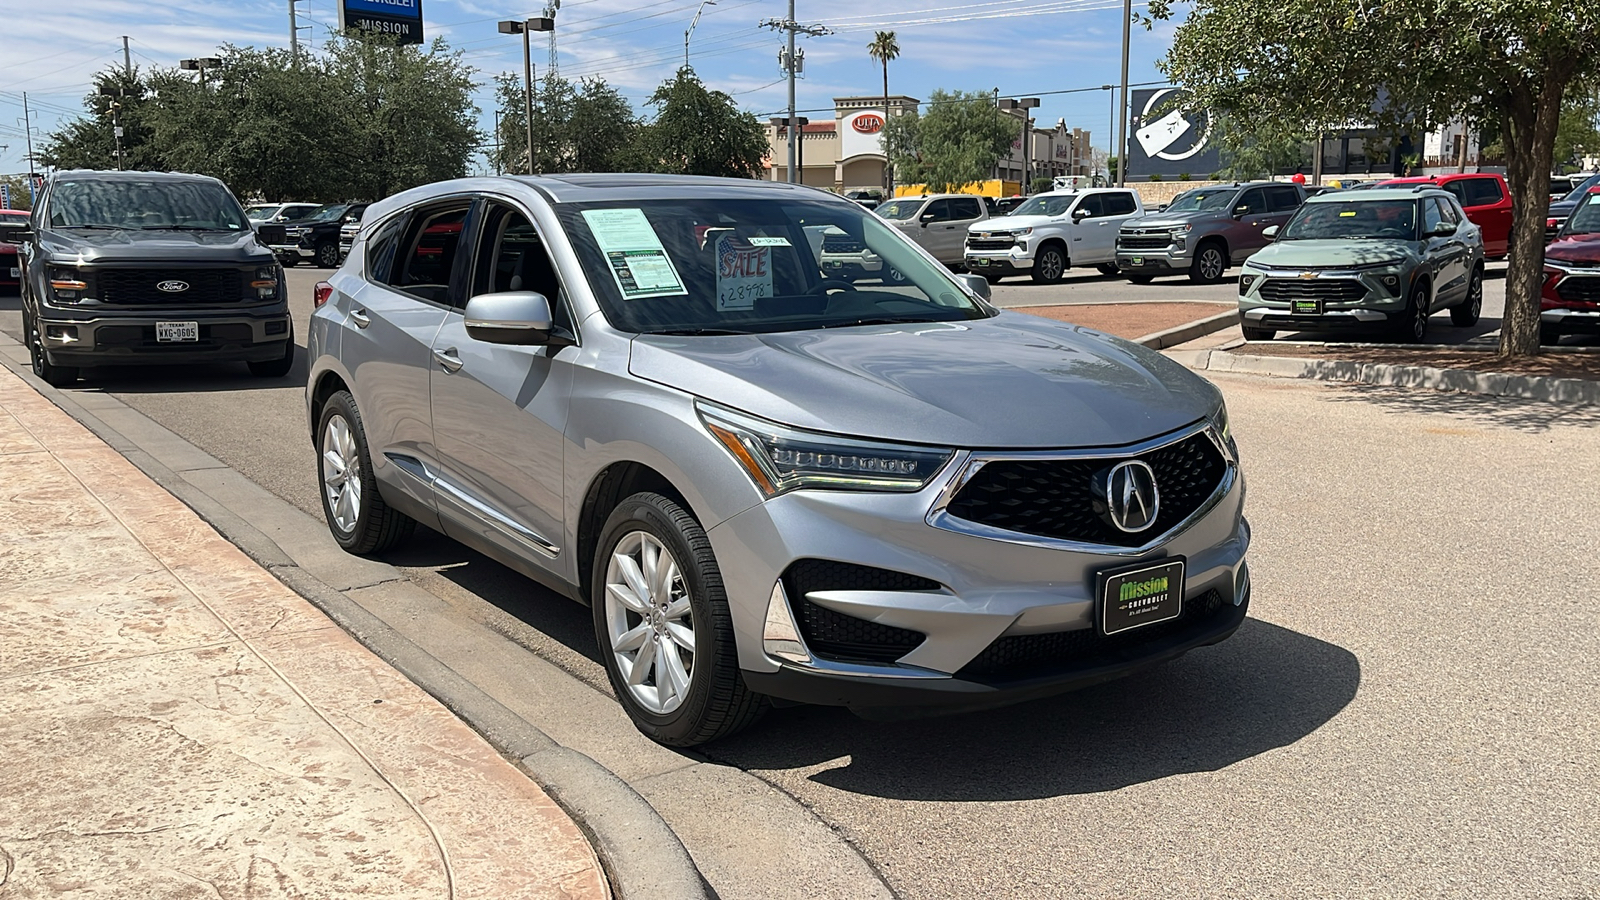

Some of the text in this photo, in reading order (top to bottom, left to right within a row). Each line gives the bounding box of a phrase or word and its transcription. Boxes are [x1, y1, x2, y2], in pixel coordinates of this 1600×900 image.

[361, 19, 409, 34] MISSION
[721, 250, 768, 278] SALE
[163, 282, 184, 290] Ford
[1119, 577, 1168, 602] Mission
[1128, 593, 1169, 609] CHEVROLET
